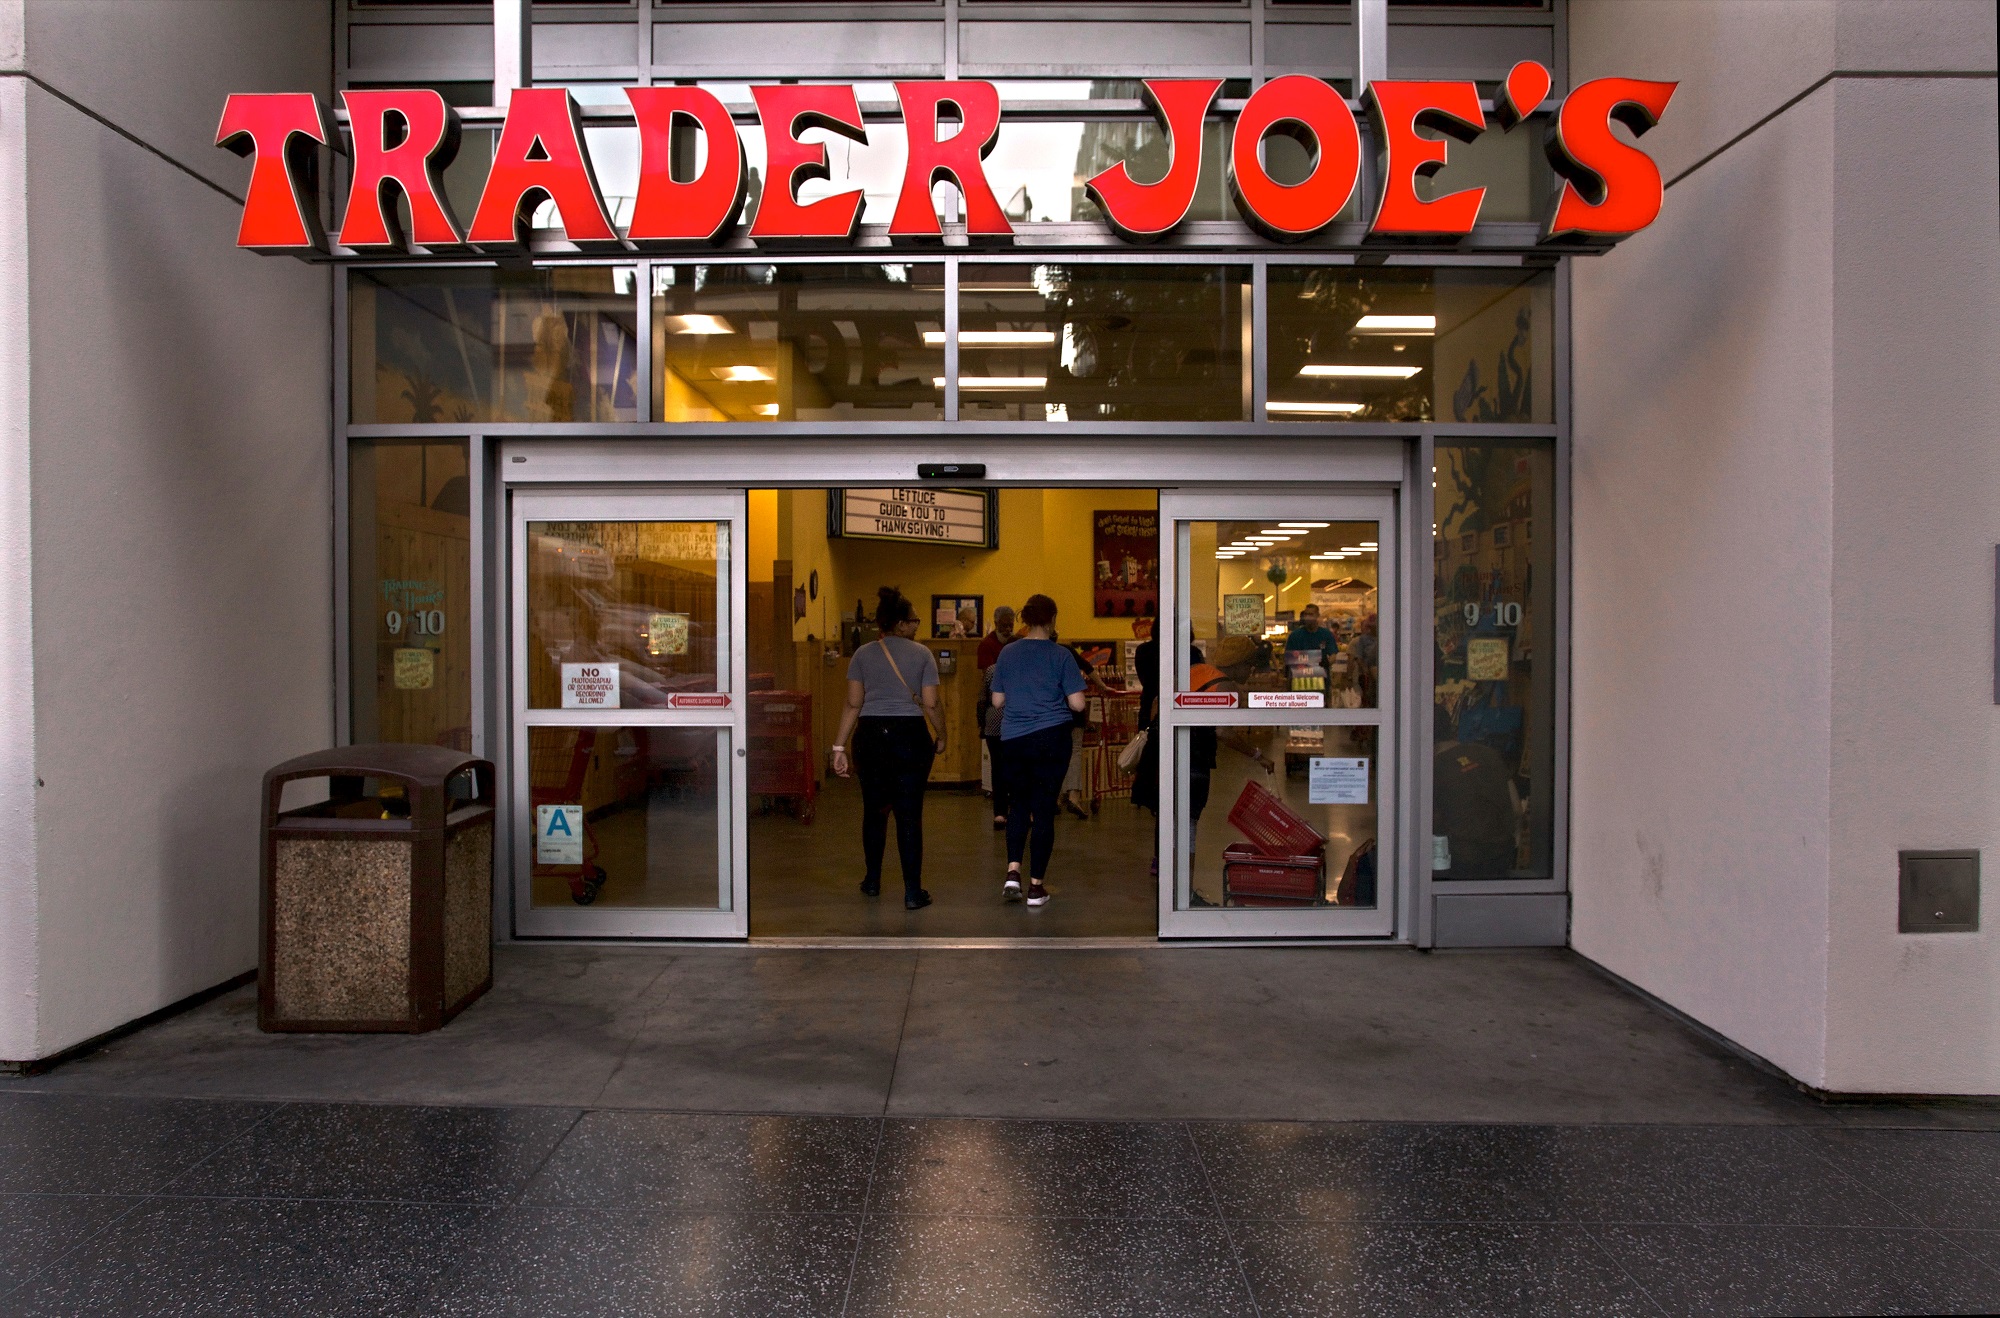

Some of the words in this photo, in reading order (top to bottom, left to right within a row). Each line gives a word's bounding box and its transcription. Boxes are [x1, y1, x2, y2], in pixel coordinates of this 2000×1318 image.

[214, 80, 1014, 248] TRADER
[1086, 60, 1680, 238] JOE'S
[892, 488, 936, 505] LETTUCE
[879, 502, 908, 517] GUIDE
[910, 506, 930, 520] YOU
[934, 508, 945, 521] TO
[386, 610, 402, 635] 9
[415, 610, 445, 635] 10
[1463, 602, 1480, 627] 9
[1492, 602, 1522, 627] 10
[581, 668, 600, 677] NO
[546, 808, 572, 836] A
